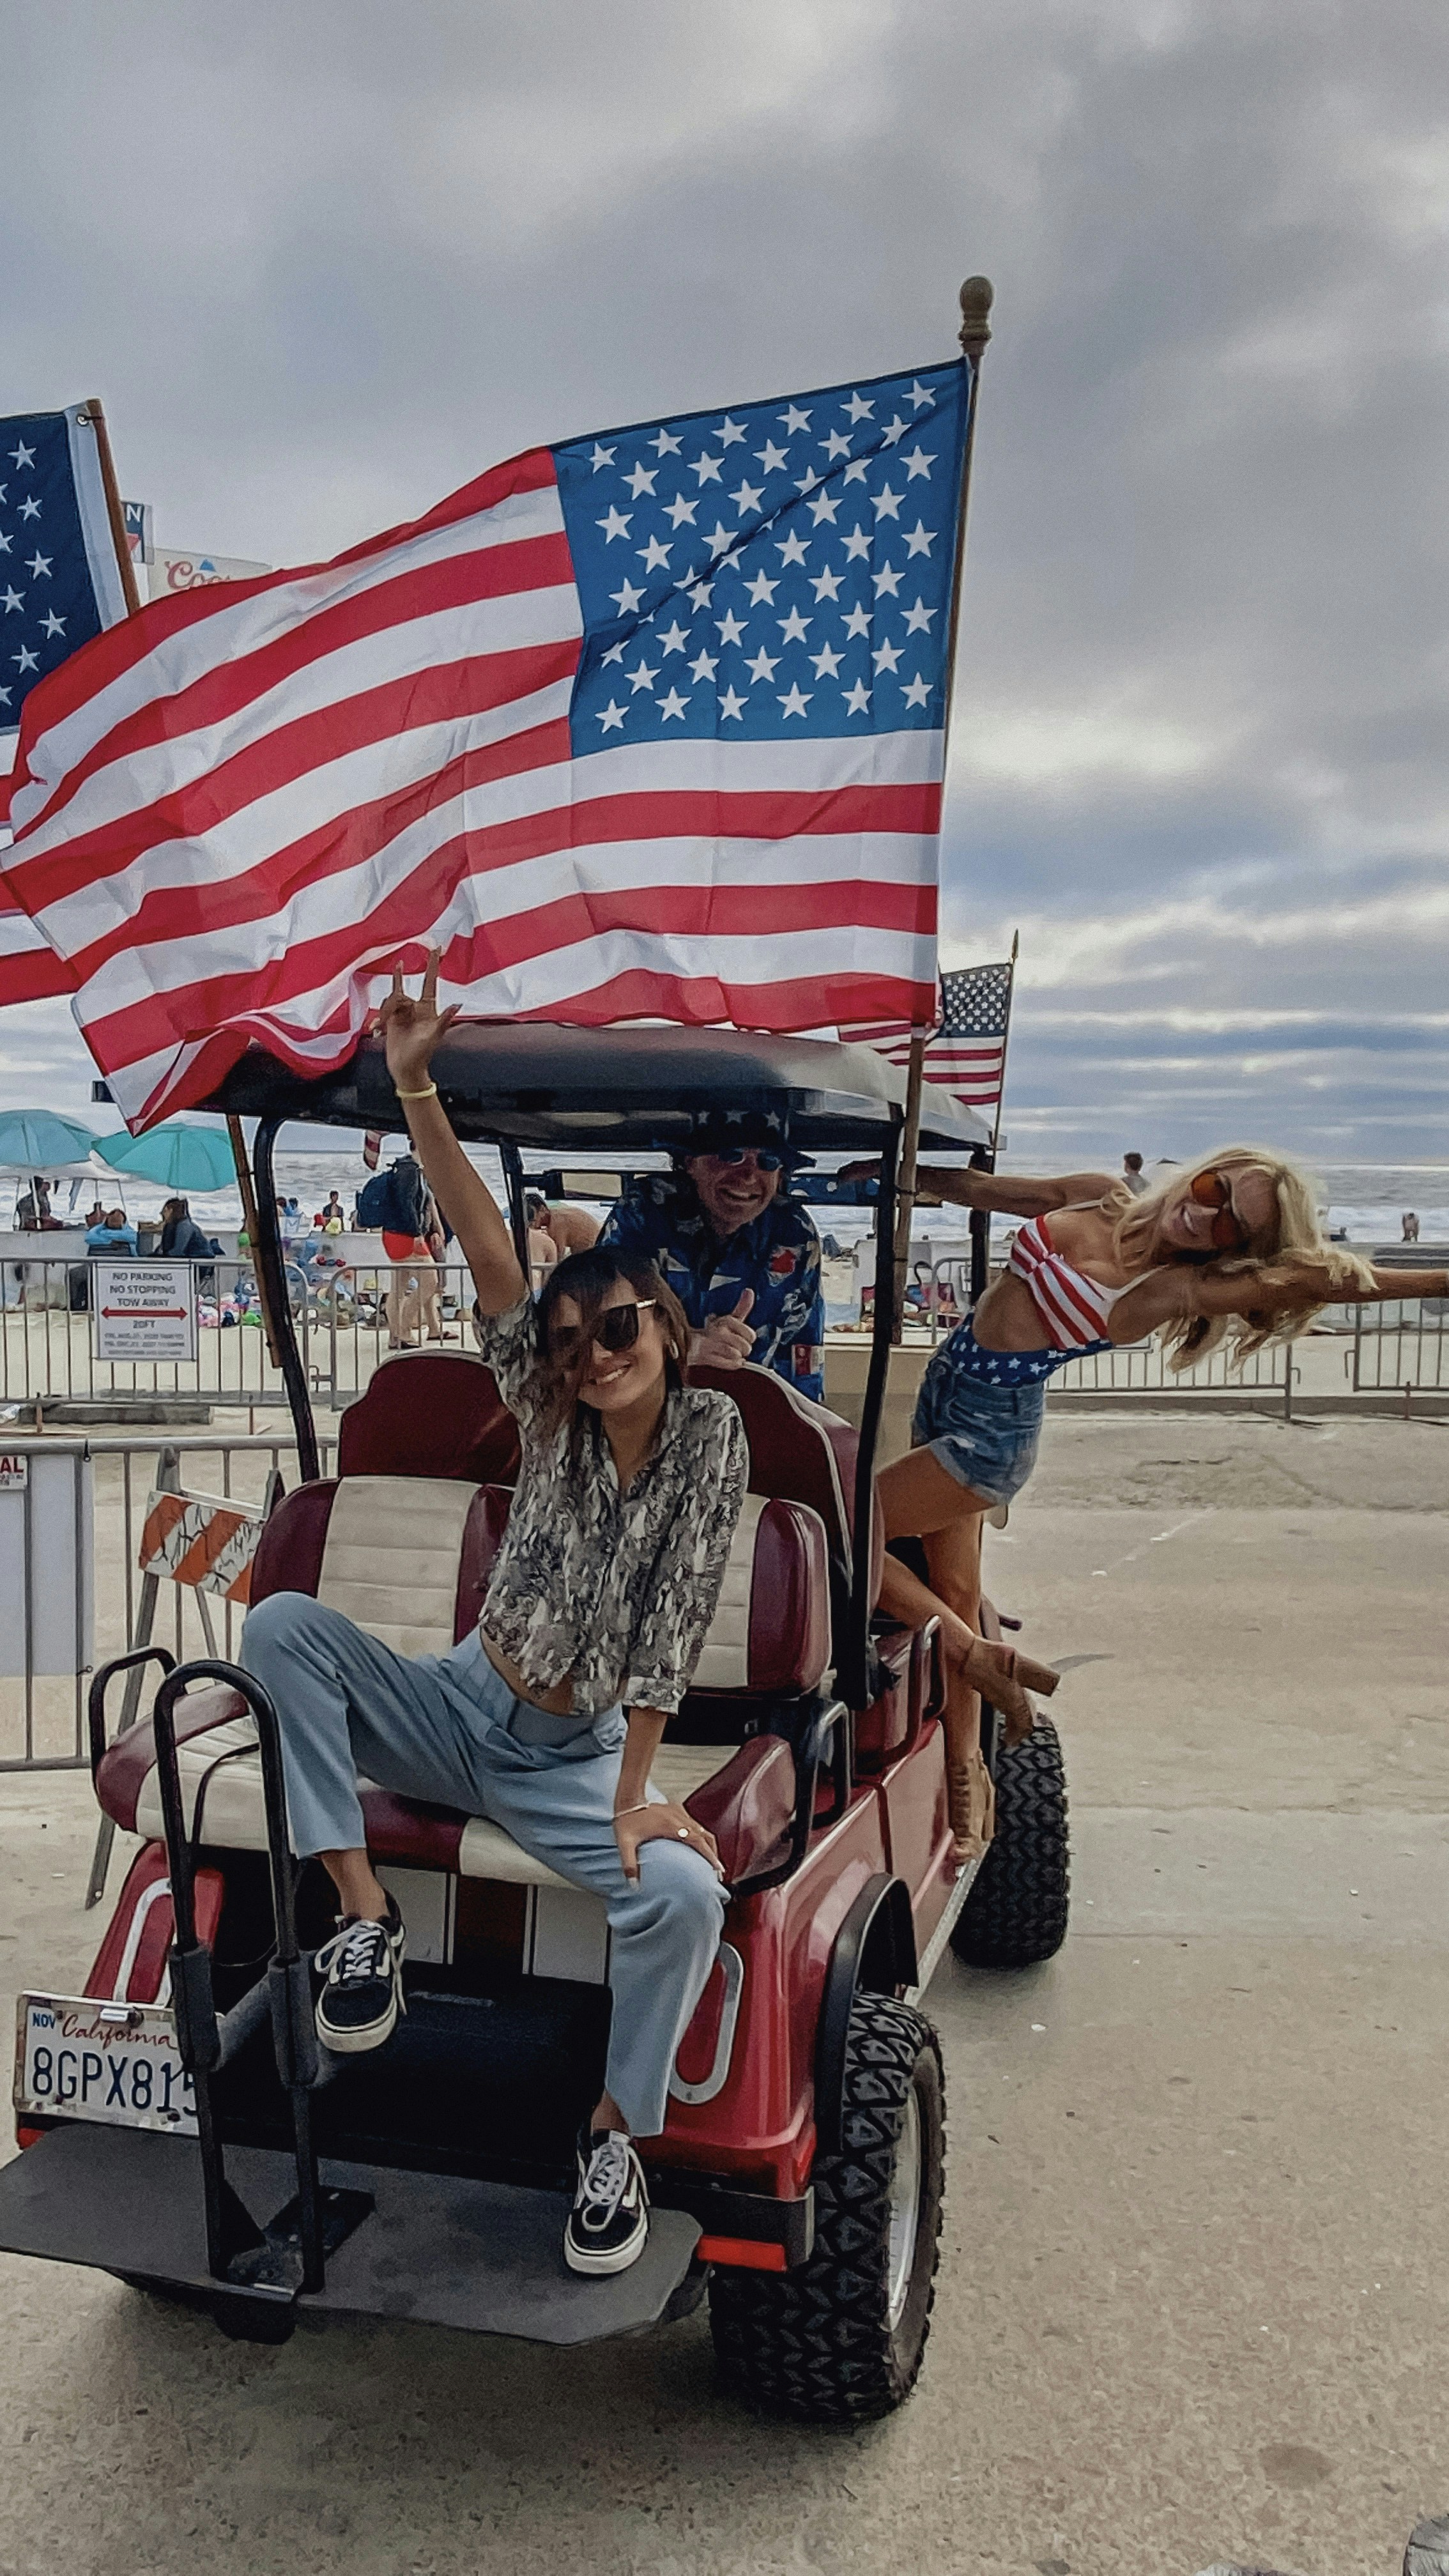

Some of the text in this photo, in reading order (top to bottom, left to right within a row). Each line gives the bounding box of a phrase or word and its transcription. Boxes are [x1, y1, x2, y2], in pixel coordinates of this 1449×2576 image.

[164, 560, 230, 589] Co
[112, 1273, 172, 1281] NO PARKING
[109, 1285, 176, 1294] NO STOPPING
[117, 1298, 169, 1307] TOW AWAY
[33, 2012, 56, 2030] NOV
[62, 2014, 178, 2050] California
